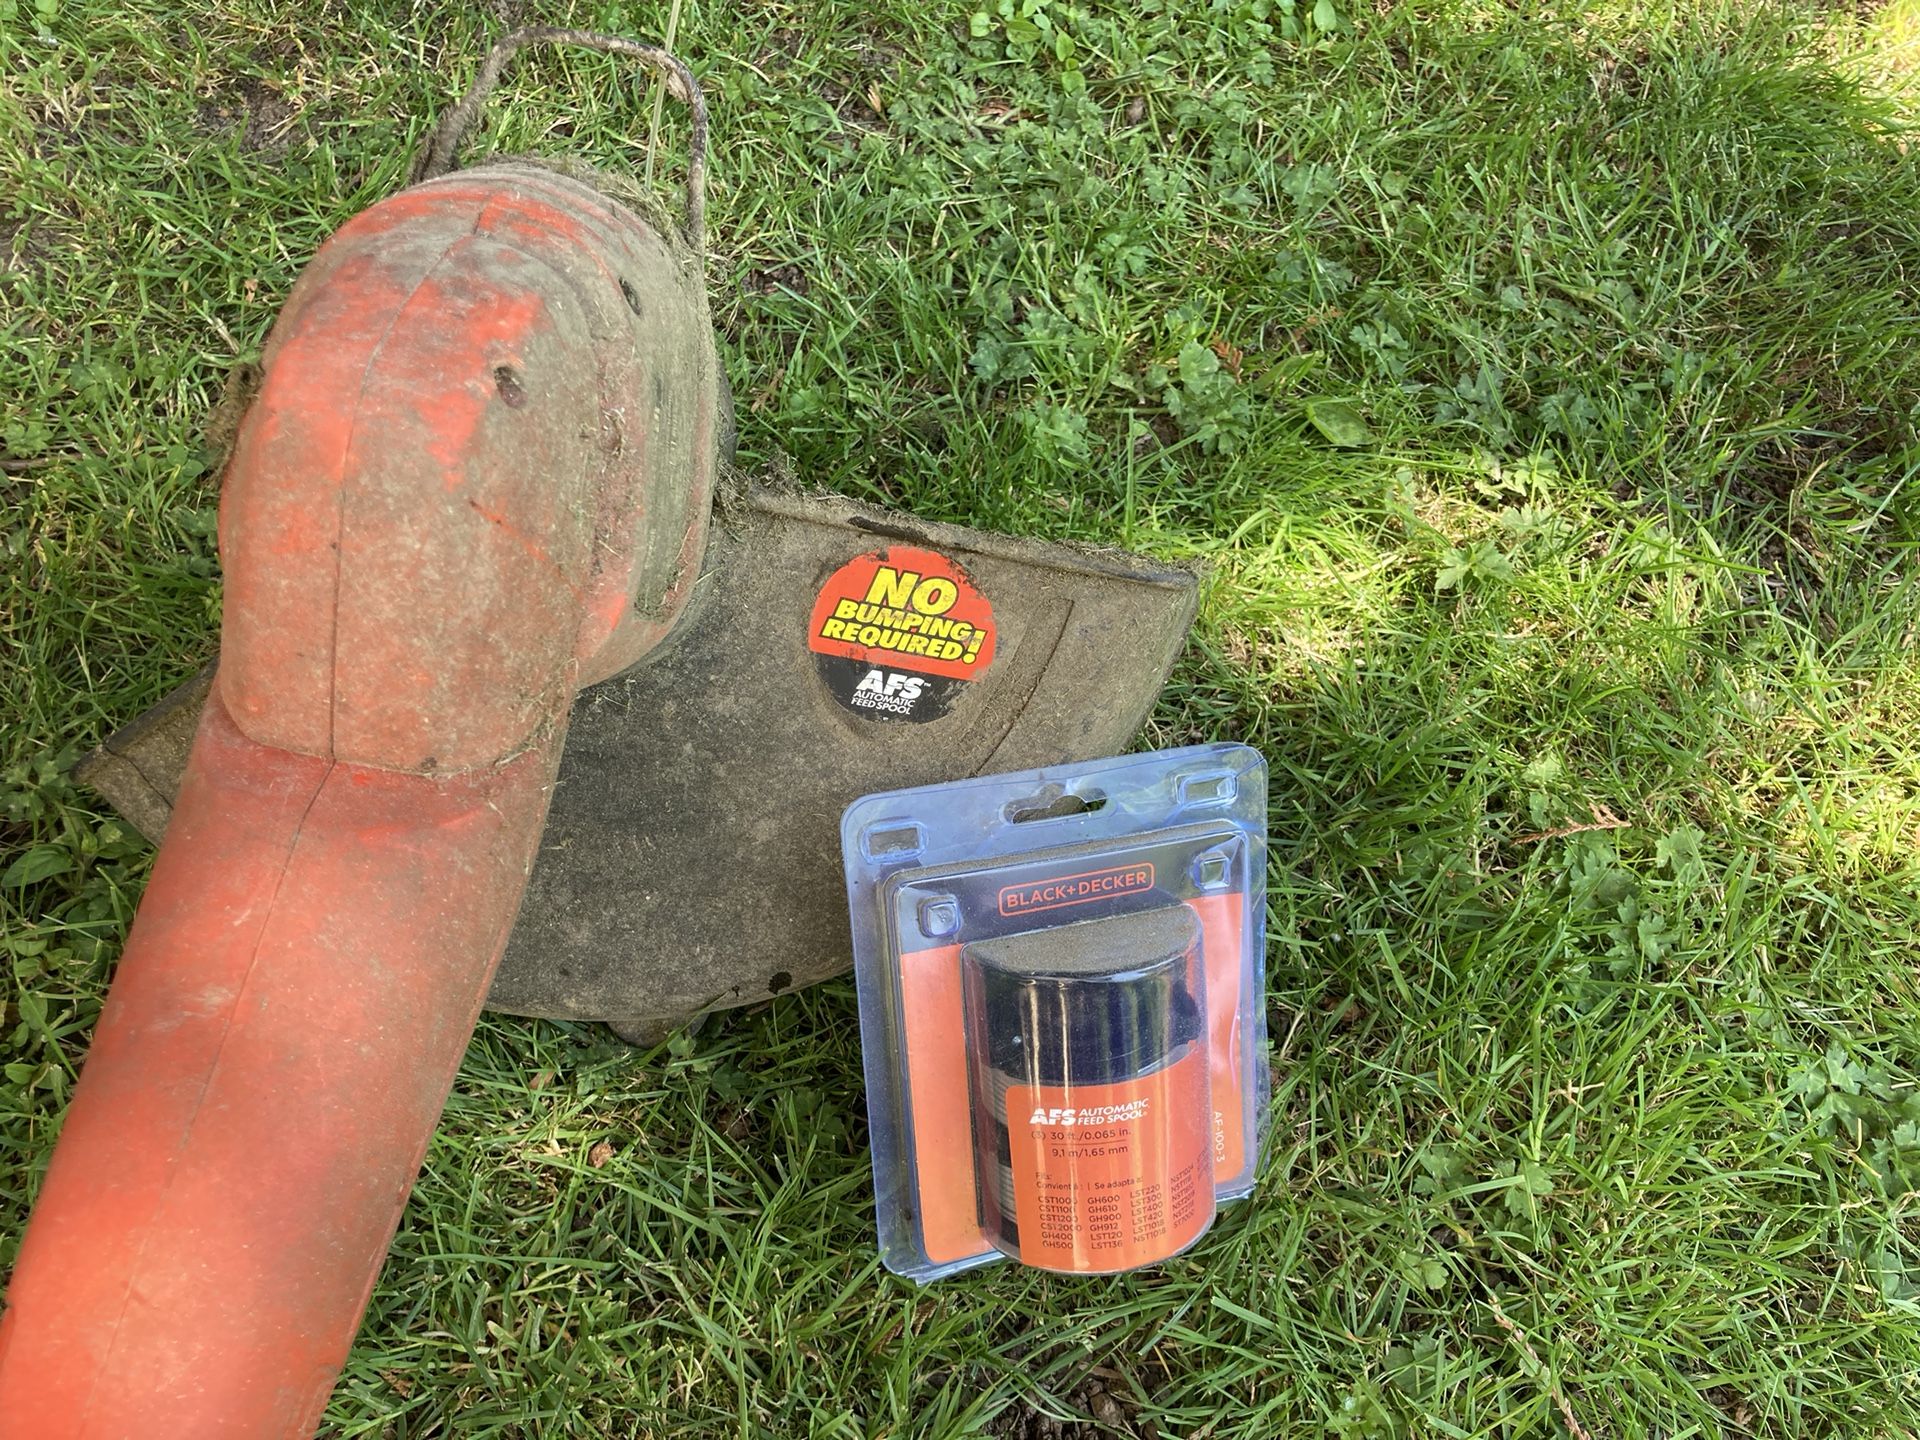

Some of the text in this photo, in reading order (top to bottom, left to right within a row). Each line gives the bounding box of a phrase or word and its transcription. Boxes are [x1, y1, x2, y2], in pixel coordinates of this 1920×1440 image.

[866, 567, 958, 615] NO
[834, 597, 972, 641] BUMPING
[819, 617, 987, 664] REQUIRED!
[851, 697, 911, 715] FEED SPOOL
[853, 690, 915, 708] AUTOMATIC
[1006, 871, 1147, 908] BLACK+DECKER
[1078, 1098, 1149, 1116] AUTOMATIC
[1029, 1108, 1077, 1126] AFS
[1077, 1117, 1105, 1126] FEED
[1050, 1131, 1065, 1140] 30
[1119, 1128, 1132, 1137] in.
[1214, 1111, 1226, 1162] AF-100-3
[1052, 1149, 1065, 1158] 9,1
[1108, 1145, 1128, 1155] mm
[1035, 1172, 1053, 1180] Fs:
[1094, 1182, 1105, 1190] Se
[1107, 1178, 1135, 1189] adapta
[1130, 1183, 1161, 1198] LST220
[1087, 1194, 1120, 1205] GH600
[1130, 1192, 1162, 1208] LST300
[1088, 1204, 1118, 1213] GH610
[1131, 1201, 1163, 1216] LST400
[1089, 1213, 1122, 1223] GH900
[1132, 1210, 1163, 1226] LST420
[1089, 1222, 1119, 1231] GH912
[1041, 1231, 1073, 1240] GH400
[1090, 1231, 1123, 1241] LST120
[1042, 1240, 1074, 1249] GH500
